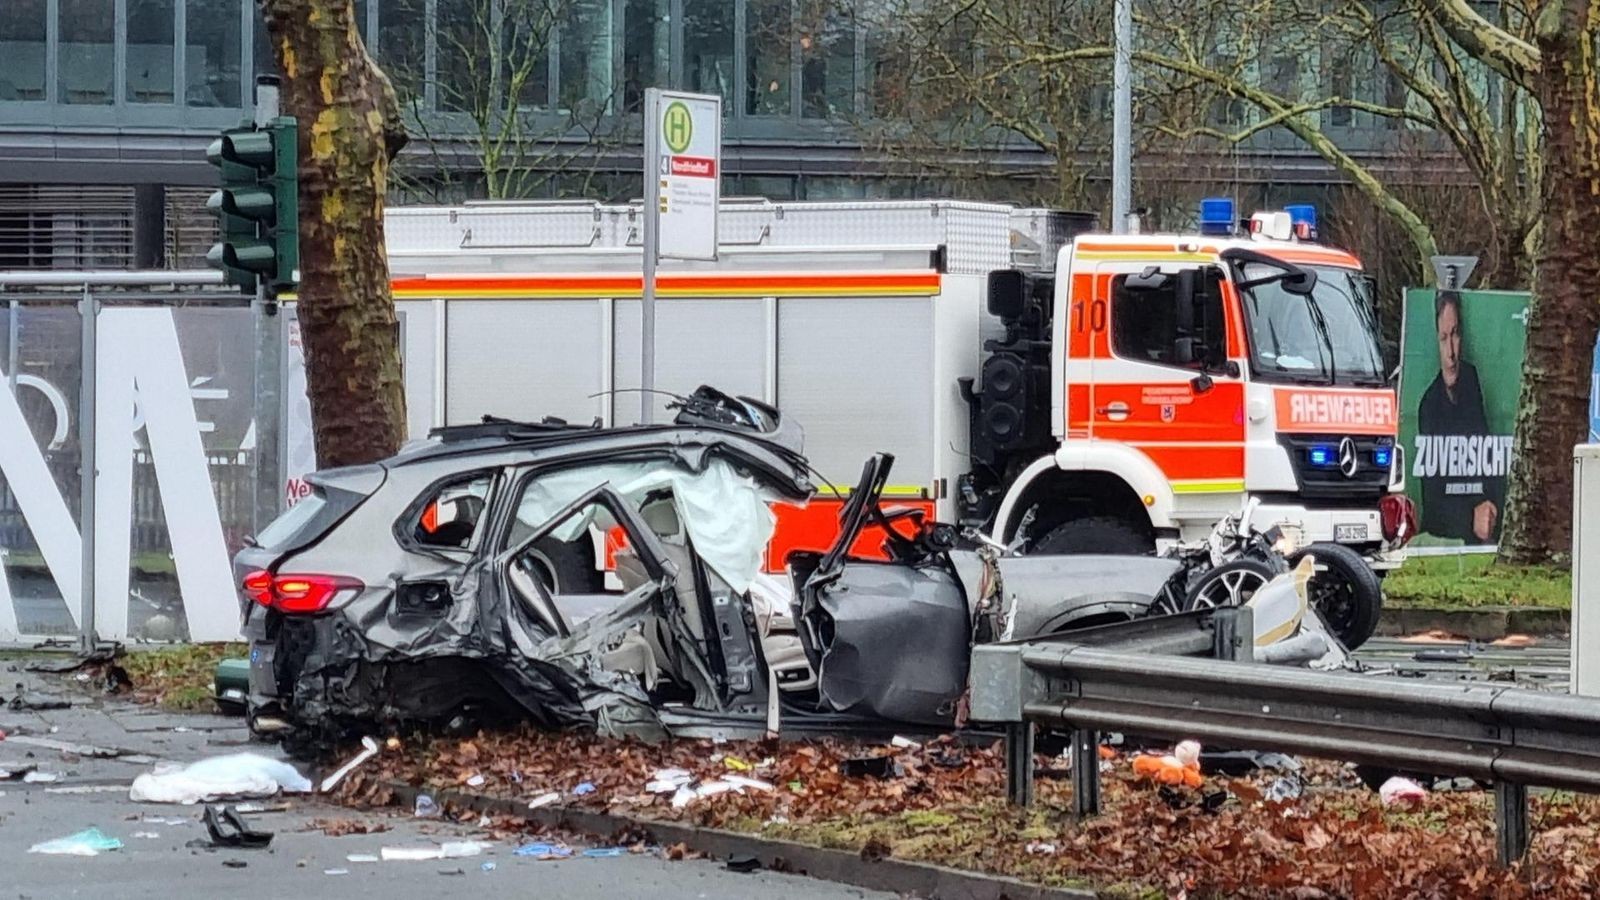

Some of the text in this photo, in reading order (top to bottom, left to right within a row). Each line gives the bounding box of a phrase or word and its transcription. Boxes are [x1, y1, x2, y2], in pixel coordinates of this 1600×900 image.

[670, 111, 685, 143] H
[1073, 299, 1107, 333] 10
[1412, 434, 1514, 477] ZUVERSICHT
